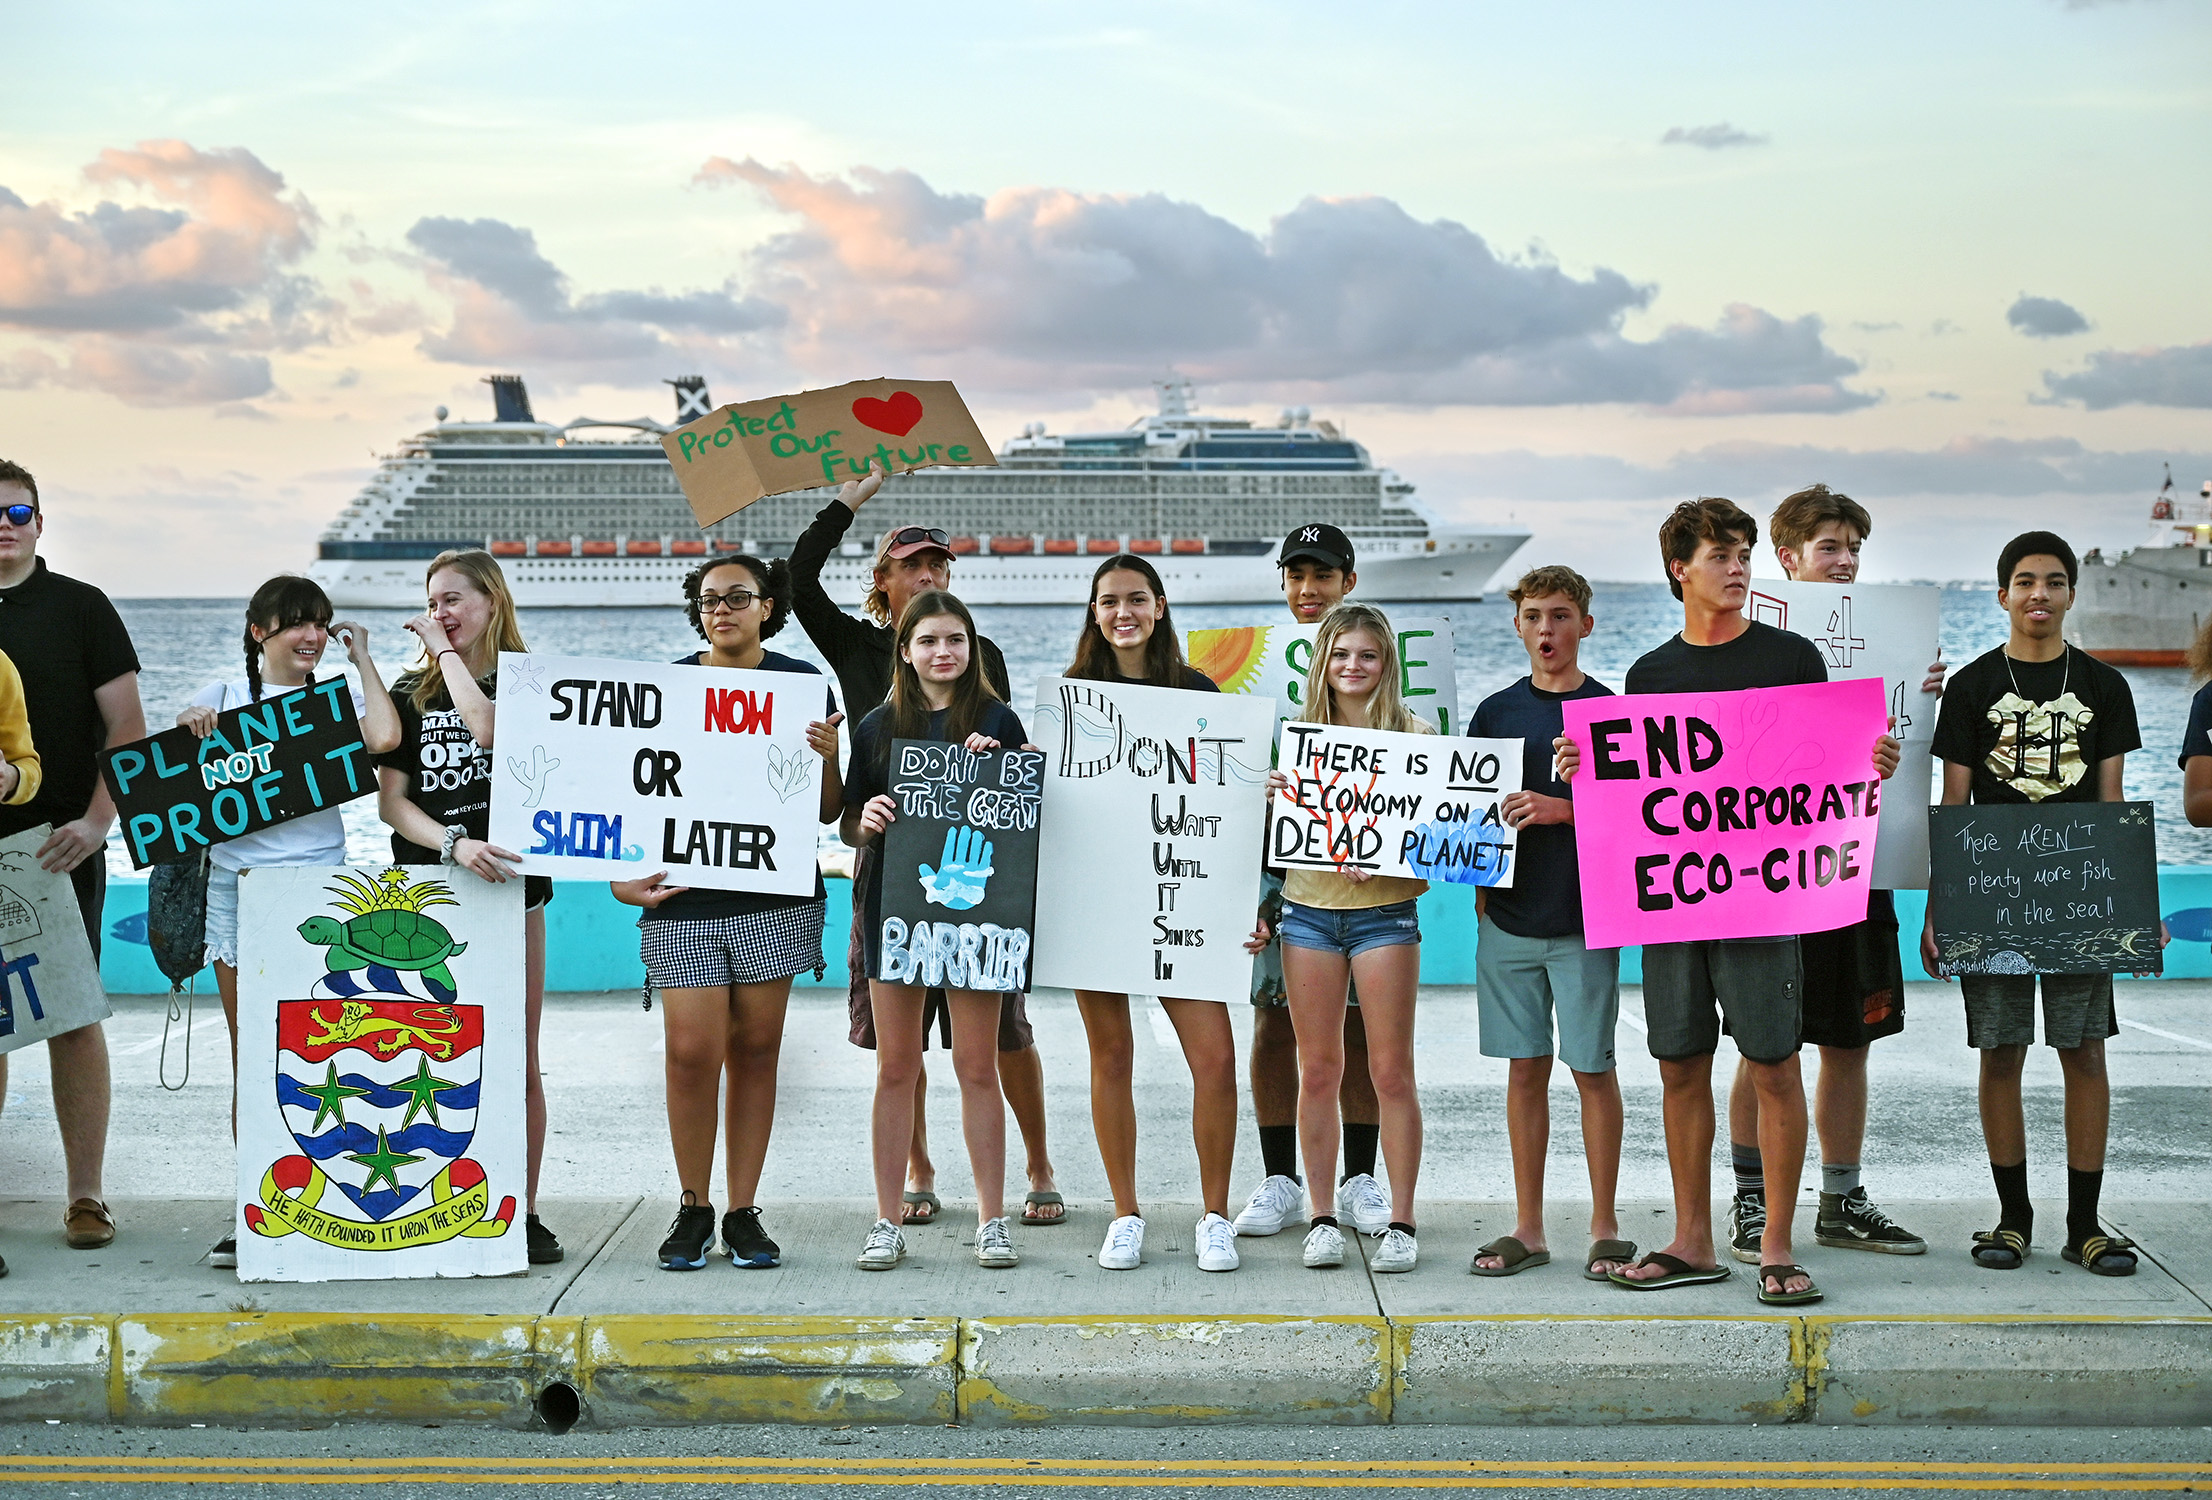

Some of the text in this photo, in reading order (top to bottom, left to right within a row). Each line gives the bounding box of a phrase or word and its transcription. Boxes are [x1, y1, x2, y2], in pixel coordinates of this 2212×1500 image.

[678, 401, 797, 462] Protect
[770, 430, 841, 458] Our
[821, 443, 973, 482] Future
[1300, 527, 1320, 542] NY
[550, 679, 773, 735] STAND NOW
[110, 679, 346, 795] PLANET
[420, 730, 444, 743] BUT
[446, 731, 460, 740] WE
[1287, 727, 1388, 774] THERE
[1406, 753, 1428, 775] IS
[1449, 750, 1500, 785] NO
[1589, 715, 1724, 780] END
[201, 742, 274, 790] NOT
[633, 747, 683, 797] OR
[1000, 751, 1043, 793] BE
[129, 741, 363, 864] PROFIT
[444, 801, 487, 816] JOIN KEY CLUB
[894, 782, 1042, 831] THE GREAT
[1296, 779, 1501, 827] ECONOMY ON A
[1641, 778, 1880, 835] CORPORATE
[531, 810, 777, 871] SWIM LATER
[1275, 816, 1514, 872] DEAD PLANET
[1955, 820, 2096, 865] There AREN'T
[1158, 883, 1180, 911] IT
[1634, 840, 1860, 912] ECO-CIDE
[1969, 868, 2021, 898] plenty
[2081, 858, 2116, 891] fish
[1996, 903, 2013, 926] in
[2024, 899, 2055, 925] the
[880, 916, 1031, 990] BARRIER
[269, 1190, 485, 1244] HE HATH FOUNDED IT UPON THE SEAS
